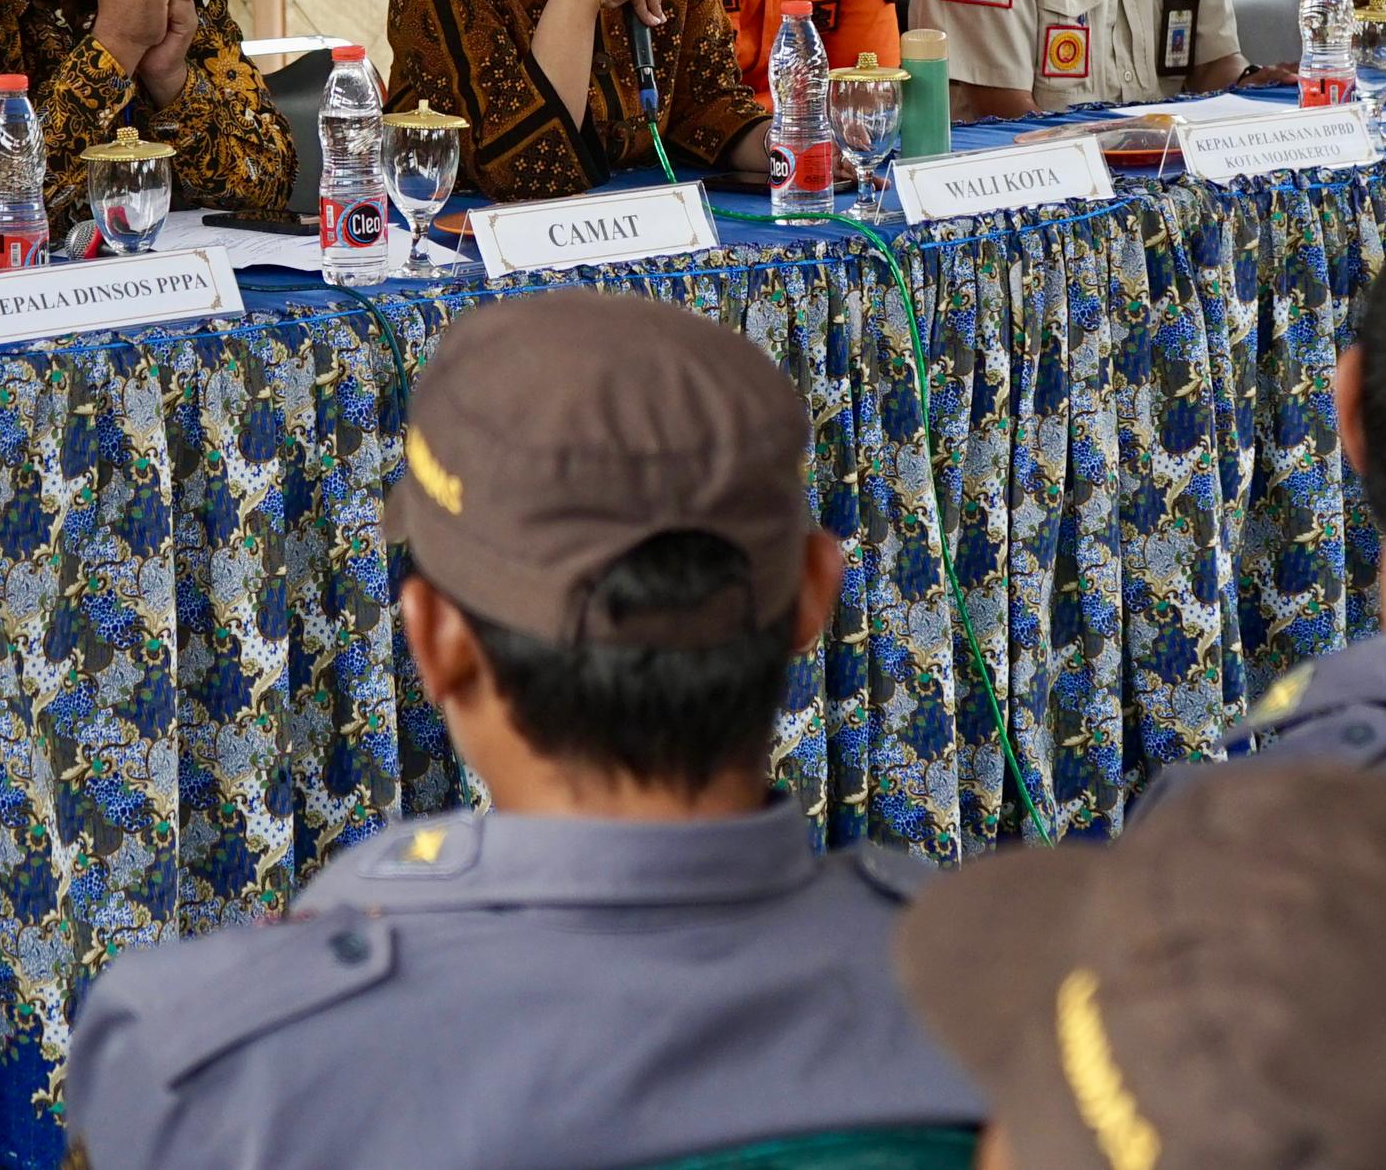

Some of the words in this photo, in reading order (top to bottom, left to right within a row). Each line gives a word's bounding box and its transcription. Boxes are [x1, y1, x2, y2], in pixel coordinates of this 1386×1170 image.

[1196, 136, 1247, 152] KEPALA
[1245, 128, 1322, 146] PELAKSANA
[1322, 122, 1355, 137] BPBD
[1224, 155, 1261, 169] KOTA
[1261, 144, 1341, 164] MOJOKERTO
[945, 175, 1001, 199] WALI
[1003, 167, 1061, 192] KOTA
[352, 213, 381, 235] Cleo
[548, 214, 639, 247] CAMAT
[73, 279, 153, 305] DINSOS
[155, 272, 208, 293] PPPA
